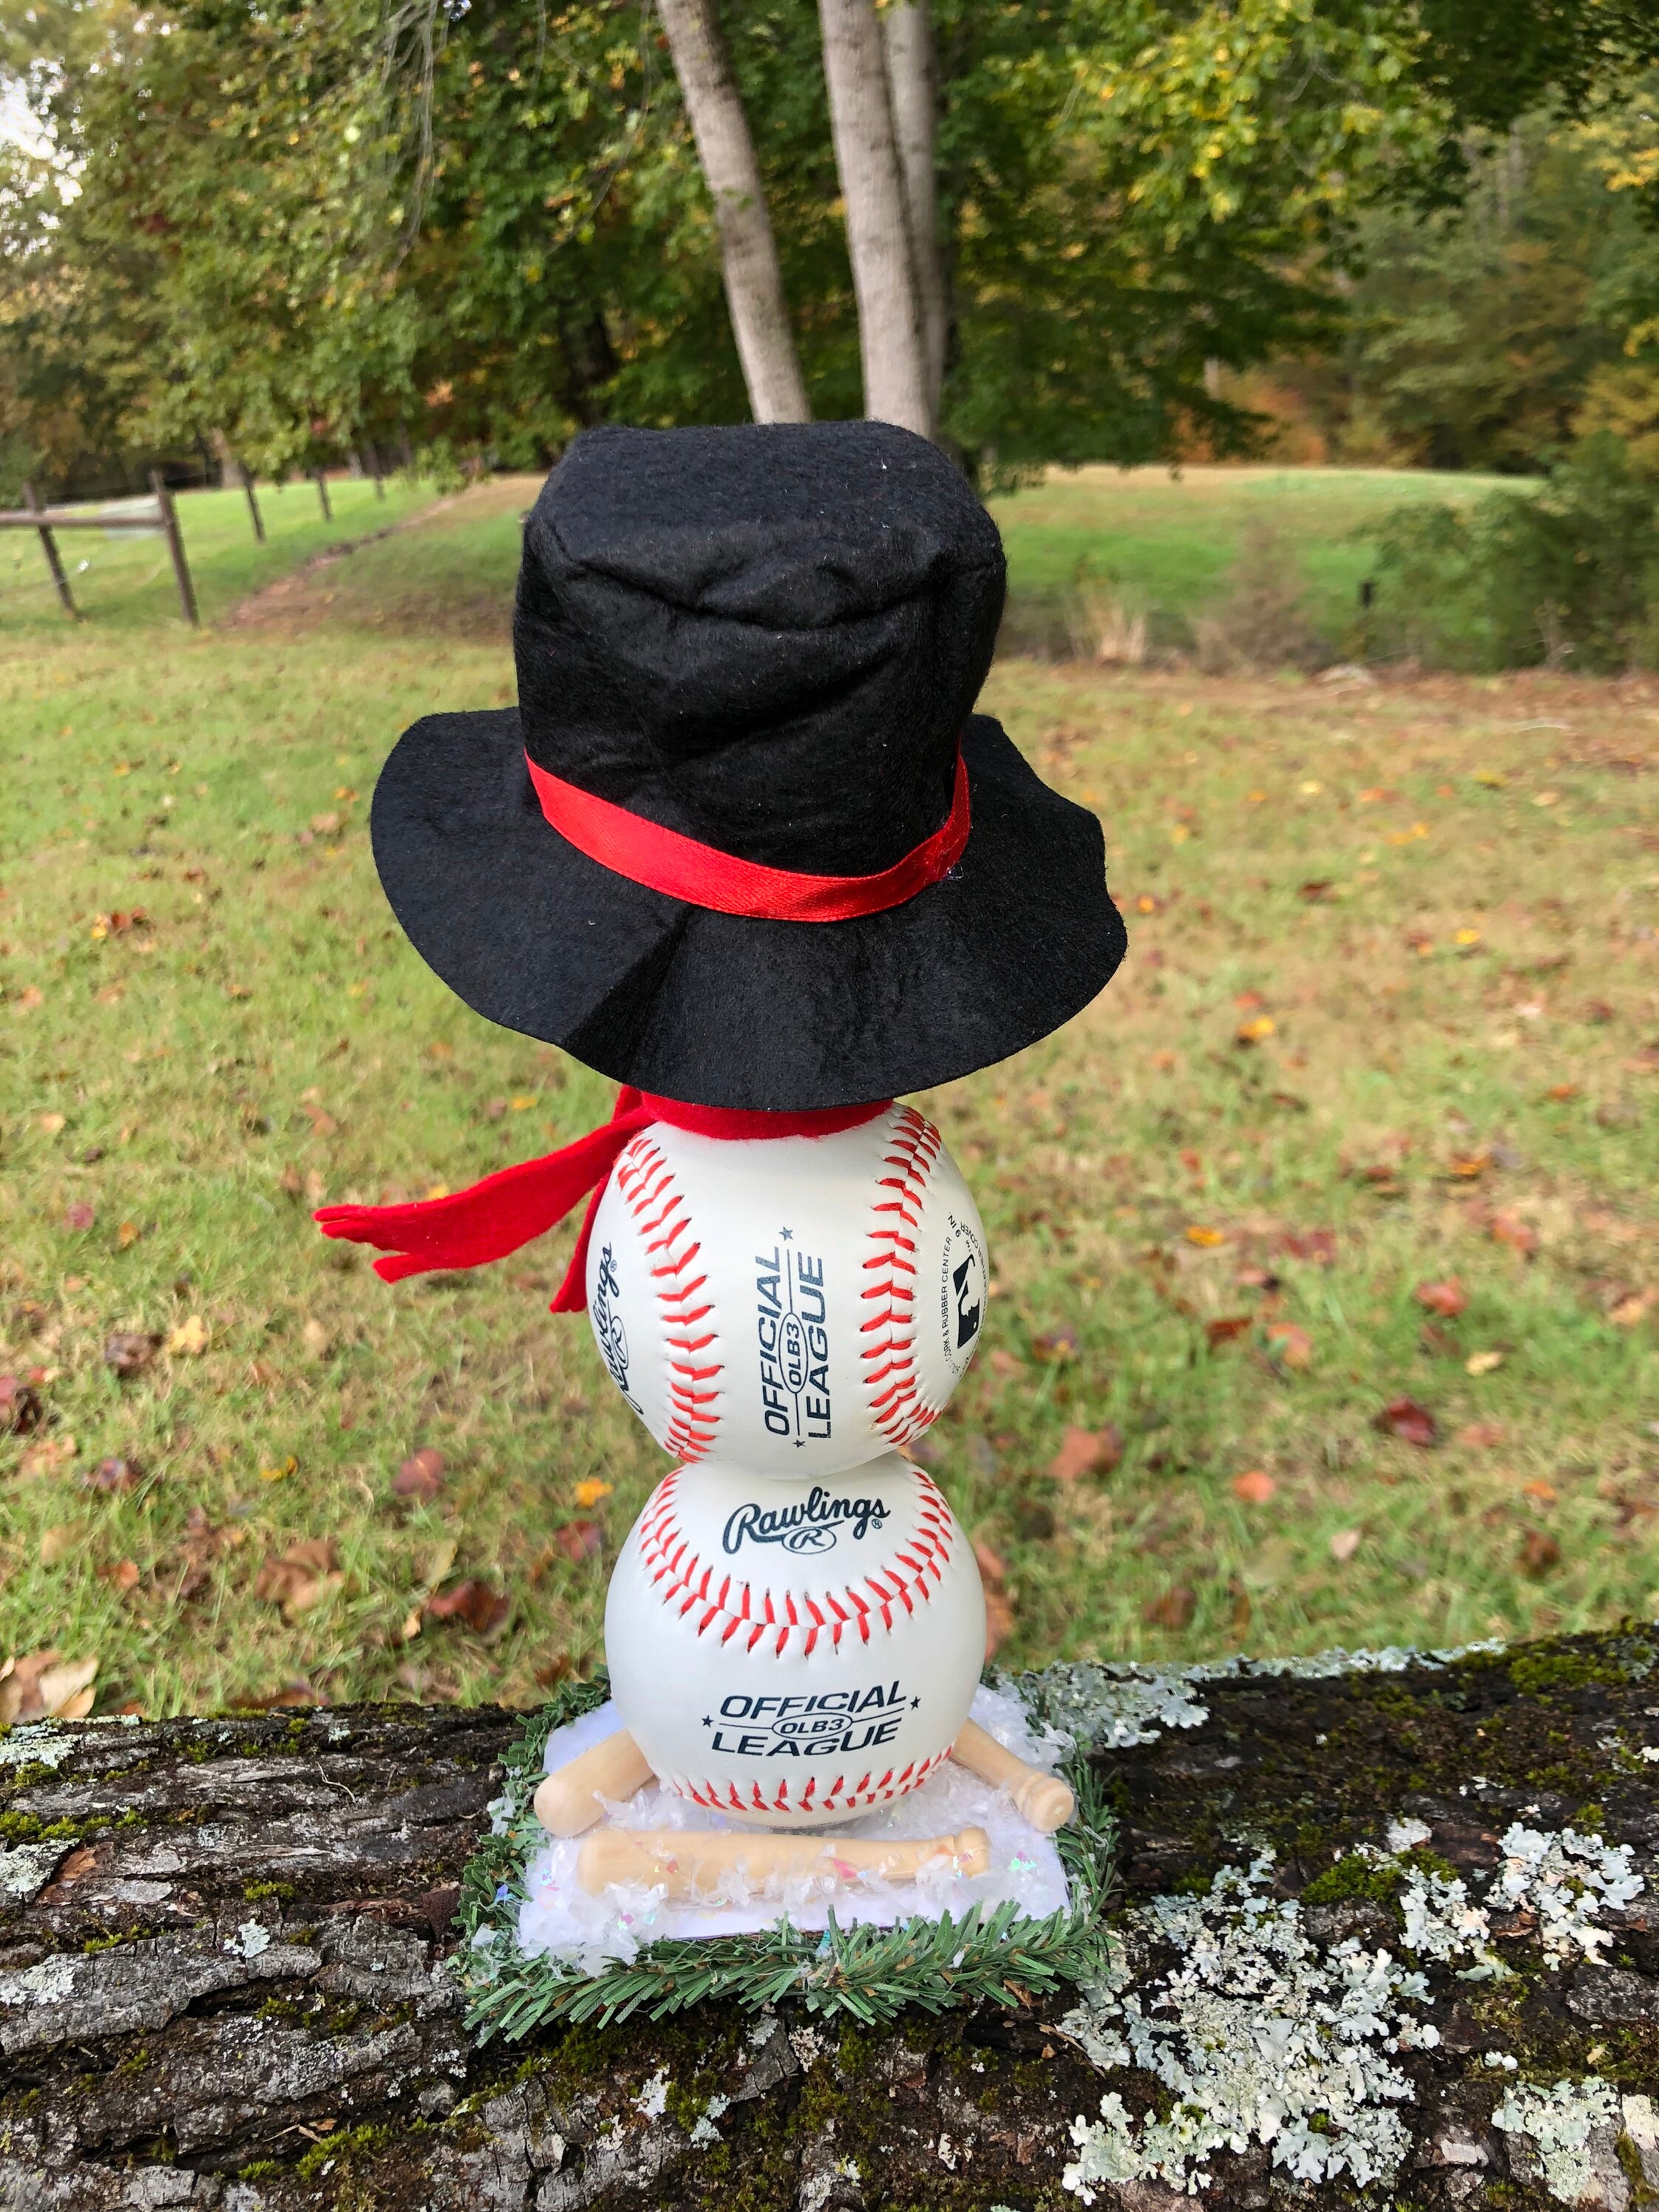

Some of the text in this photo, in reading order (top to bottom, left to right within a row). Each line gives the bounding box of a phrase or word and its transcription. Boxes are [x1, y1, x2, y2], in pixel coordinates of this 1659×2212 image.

[960, 1221, 979, 1249] COVER
[941, 1236, 952, 1283] CENTER
[593, 1241, 645, 1416] Rawlings
[941, 1286, 949, 1329] RUBBER
[755, 1246, 790, 1436] OFFICIAL
[787, 1321, 802, 1388] OLB3
[797, 1251, 832, 1439] LEAGUE
[942, 1329, 949, 1337] &
[722, 1486, 892, 1555] Rawlings
[719, 1680, 907, 1720] OFFICIAL
[711, 1717, 903, 1757] LEAGUE
[779, 1718, 846, 1734] OLB3
